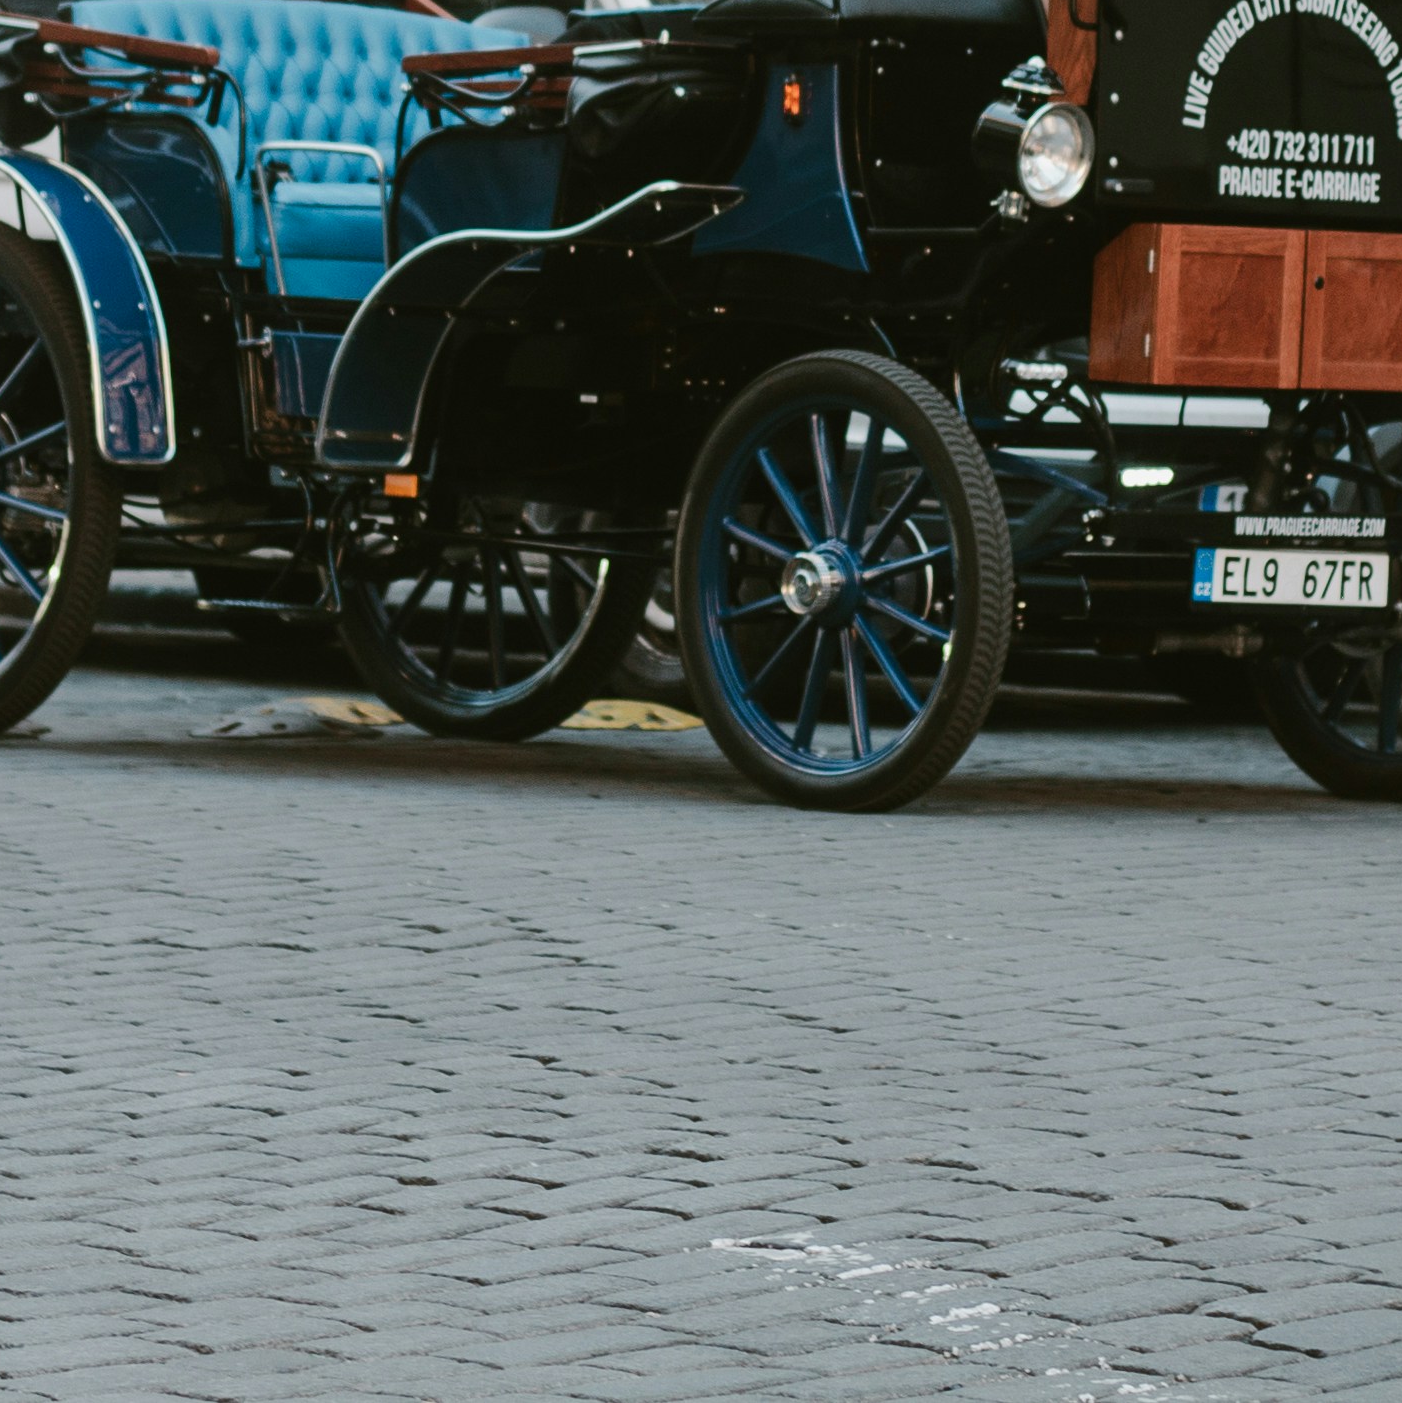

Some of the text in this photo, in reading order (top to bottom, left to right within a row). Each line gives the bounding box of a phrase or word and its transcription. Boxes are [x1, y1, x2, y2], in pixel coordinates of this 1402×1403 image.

[1197, 0, 1255, 76] GUIDED
[1182, 70, 1214, 129] LIVE
[1226, 128, 1375, 165] +420 732 311 711
[1218, 164, 1381, 203] PRAGUE E-CARRIAGE
[1235, 516, 1386, 537] WWW.PRAGUEECARRIAGE.COM
[1222, 556, 1279, 597] EL9
[1302, 560, 1373, 601] 67FR
